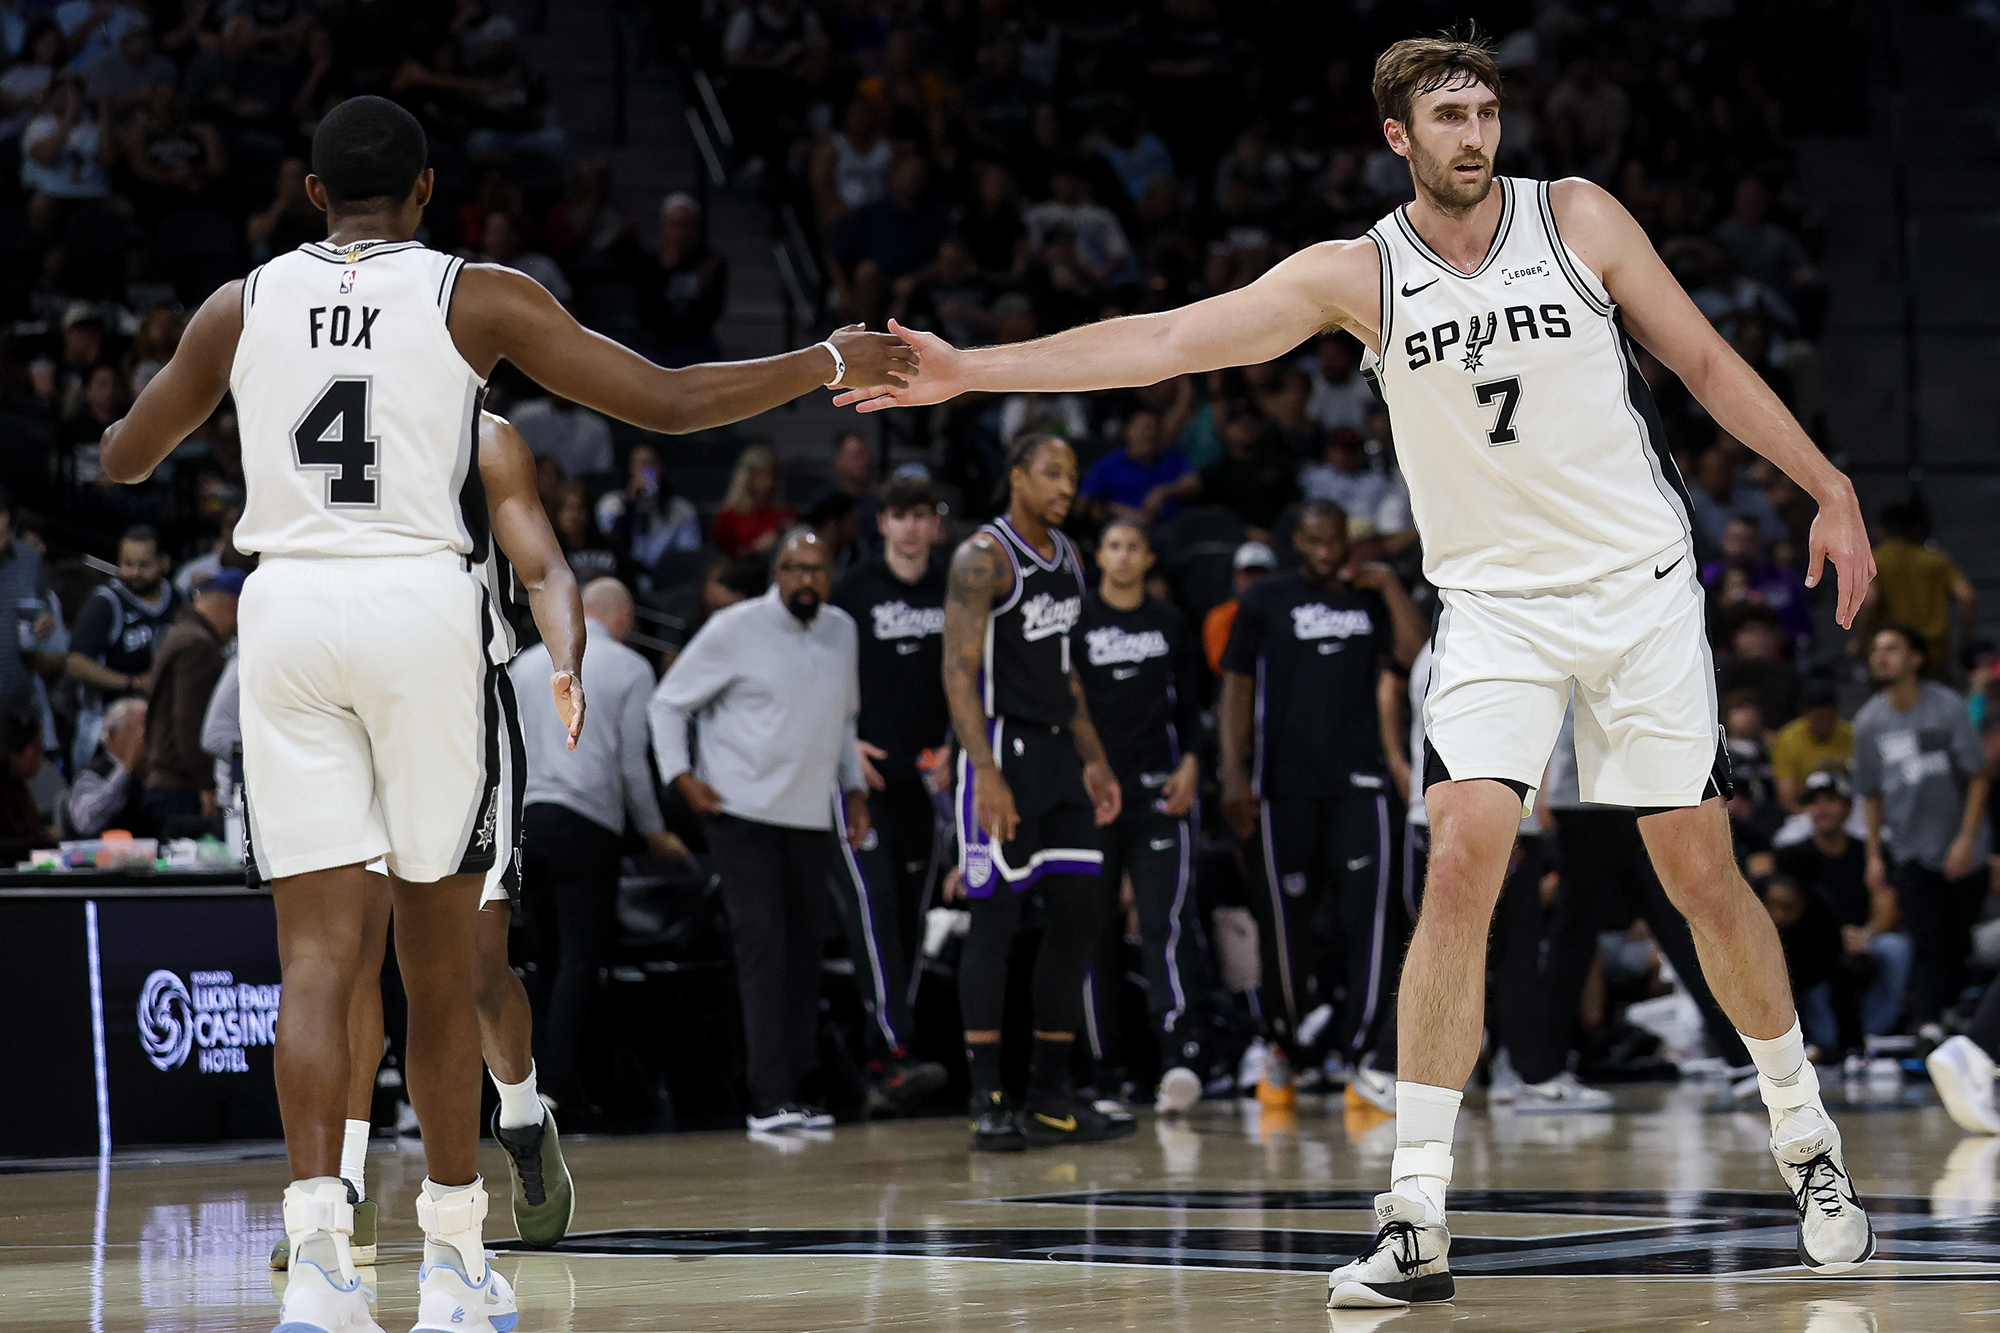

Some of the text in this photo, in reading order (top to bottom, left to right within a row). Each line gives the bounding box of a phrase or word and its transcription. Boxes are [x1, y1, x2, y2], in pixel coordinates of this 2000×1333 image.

[1508, 265, 1543, 280] LEDGER
[310, 305, 381, 350] FOX
[1405, 304, 1572, 373] SPURS
[1472, 374, 1523, 447] 7
[288, 374, 382, 510] 4
[199, 1047, 249, 1073] HOTEL
